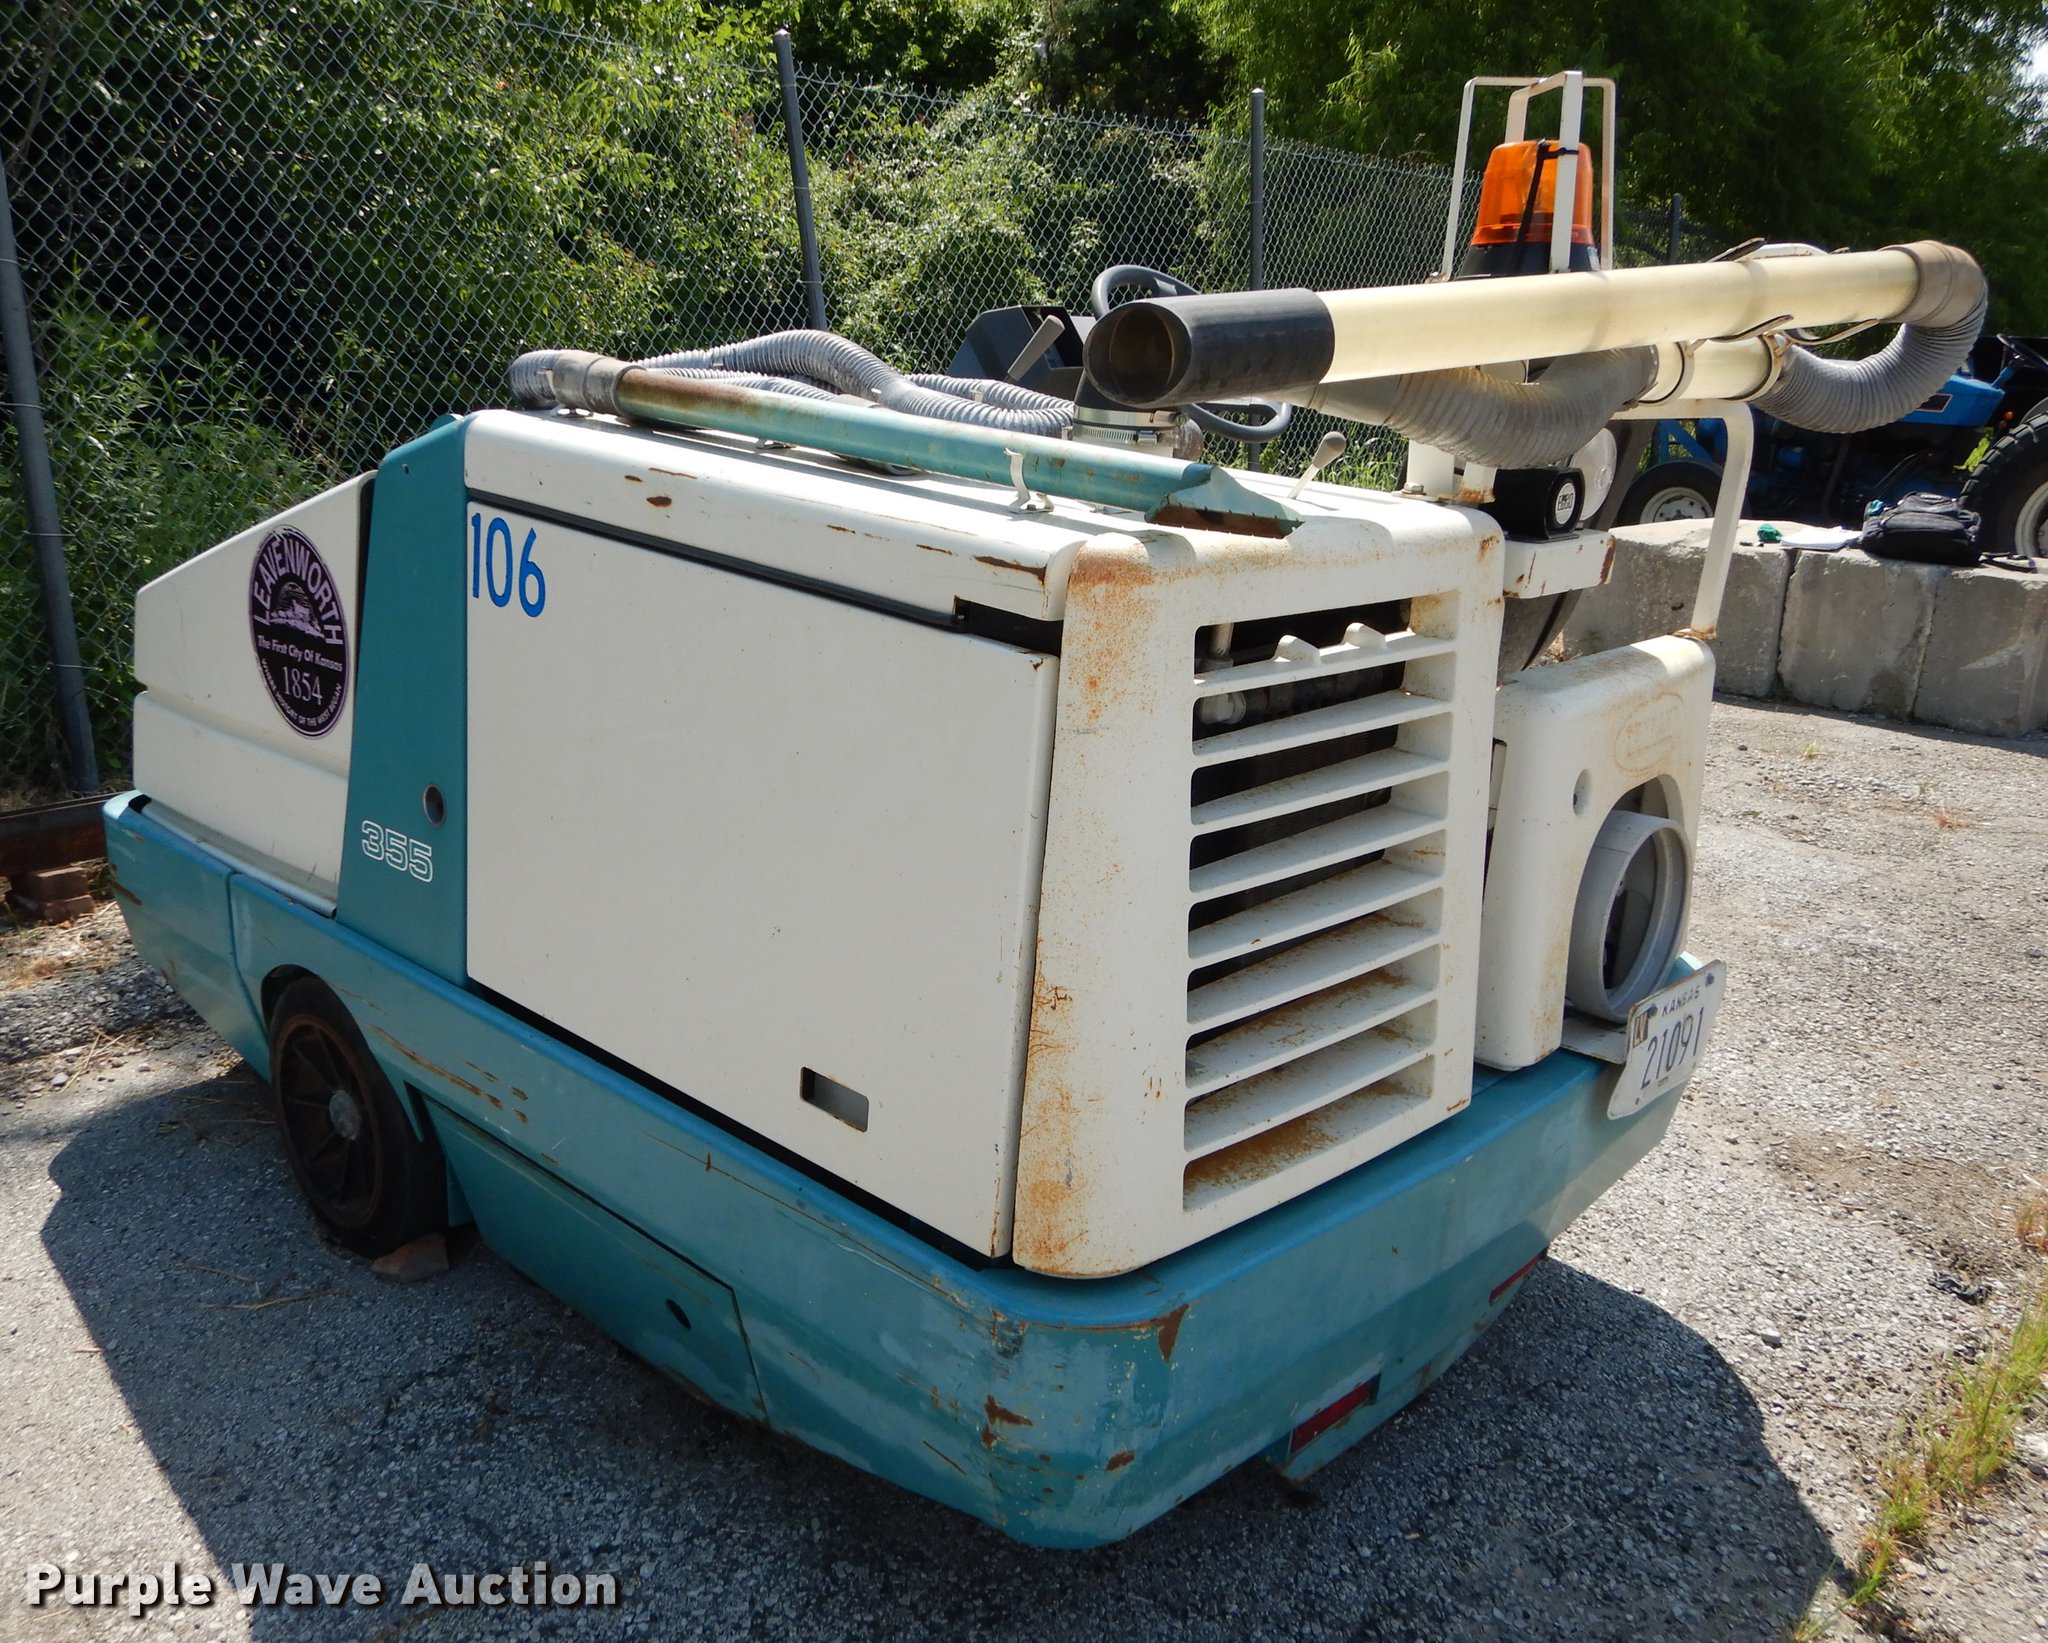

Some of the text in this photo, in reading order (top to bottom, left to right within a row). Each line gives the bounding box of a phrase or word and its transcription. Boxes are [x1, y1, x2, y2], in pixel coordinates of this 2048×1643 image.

[252, 537, 344, 645] LEAVENWORTH
[472, 512, 546, 618] 106
[257, 635, 343, 672] The First City Of Kansas
[282, 666, 323, 706] 1854
[362, 819, 433, 883] 355
[1661, 984, 1701, 1017] KANSAS
[1640, 1006, 1705, 1090] 21091
